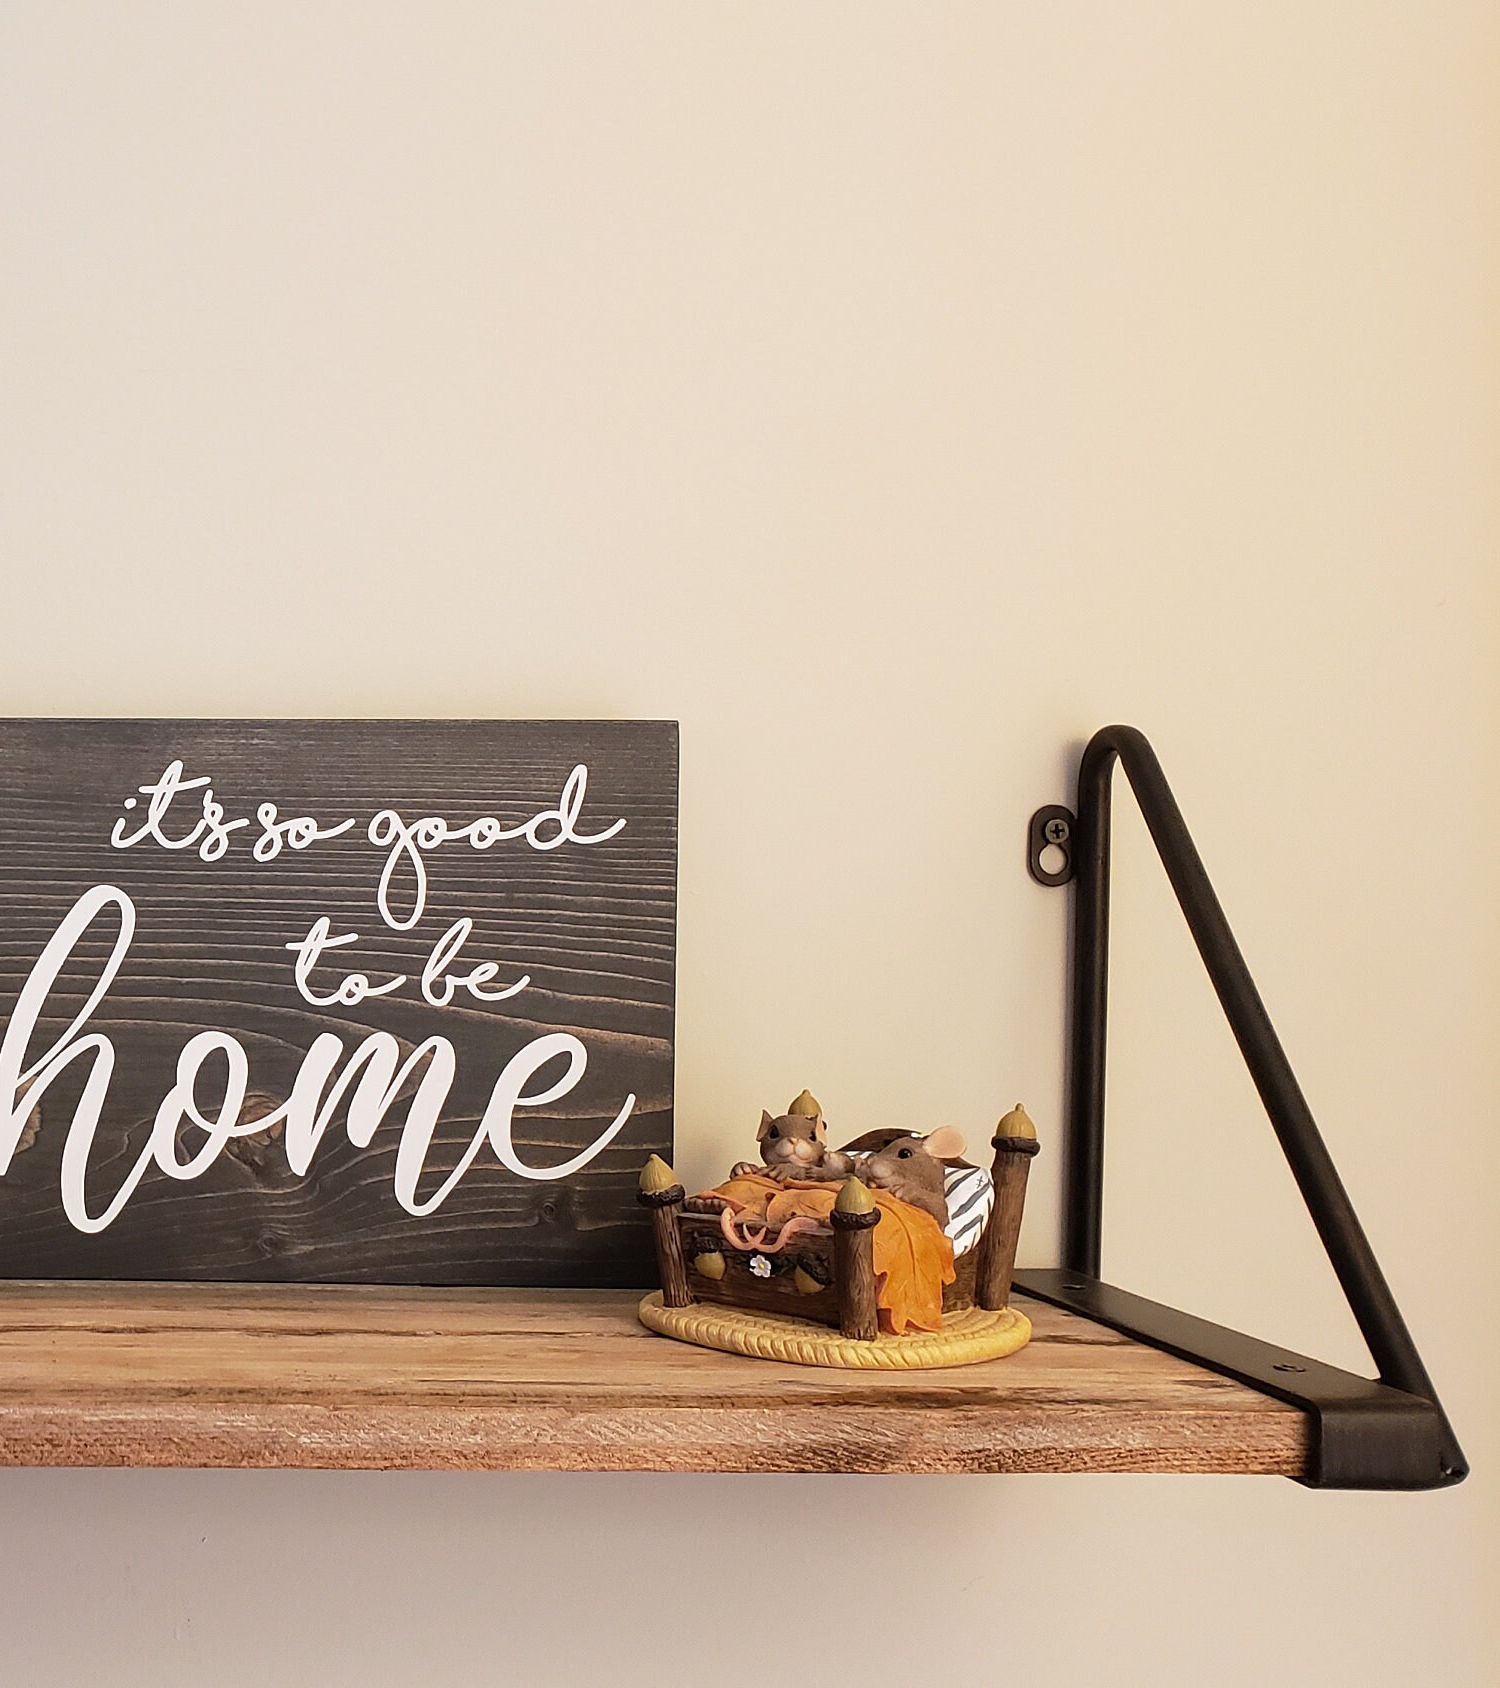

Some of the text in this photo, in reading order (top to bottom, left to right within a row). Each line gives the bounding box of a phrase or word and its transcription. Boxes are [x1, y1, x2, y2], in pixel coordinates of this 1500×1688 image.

[110, 759, 627, 931] it's so good
[285, 916, 531, 1007] to be
